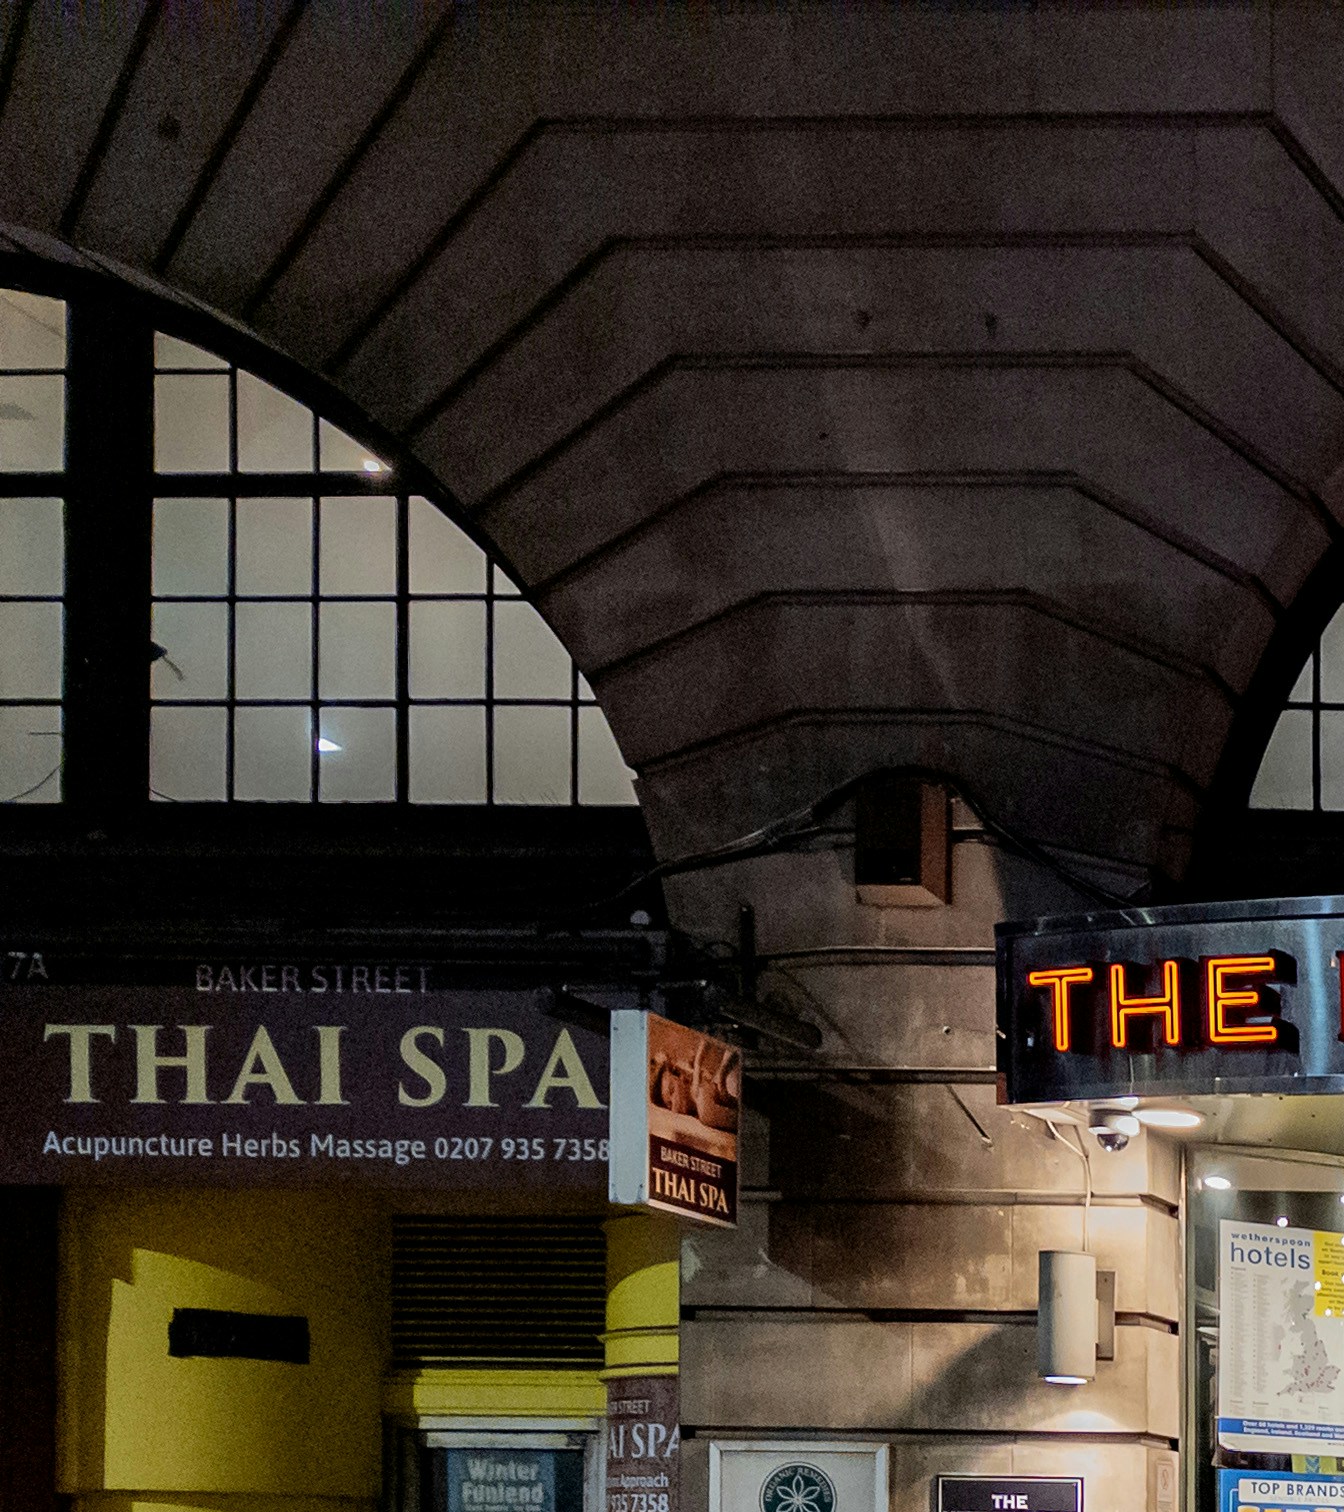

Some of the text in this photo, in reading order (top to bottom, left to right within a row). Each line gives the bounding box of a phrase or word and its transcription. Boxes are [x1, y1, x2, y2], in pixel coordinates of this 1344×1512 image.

[8, 952, 48, 980] 7A
[196, 965, 433, 994] BAKER STREET
[1029, 955, 1279, 1053] THE
[43, 1025, 609, 1109] THAI SPA
[43, 1131, 609, 1165] Acupuncture Herbs Massage 0207 935 7358
[661, 1146, 722, 1178] BAKER STREET
[653, 1167, 729, 1214] THAI SPA
[1231, 1233, 1311, 1247] wetherspoon
[1231, 1242, 1311, 1269] hotels
[467, 1458, 540, 1481] Winter
[991, 1494, 1028, 1510] THE
[1251, 1481, 1281, 1495] TOP
